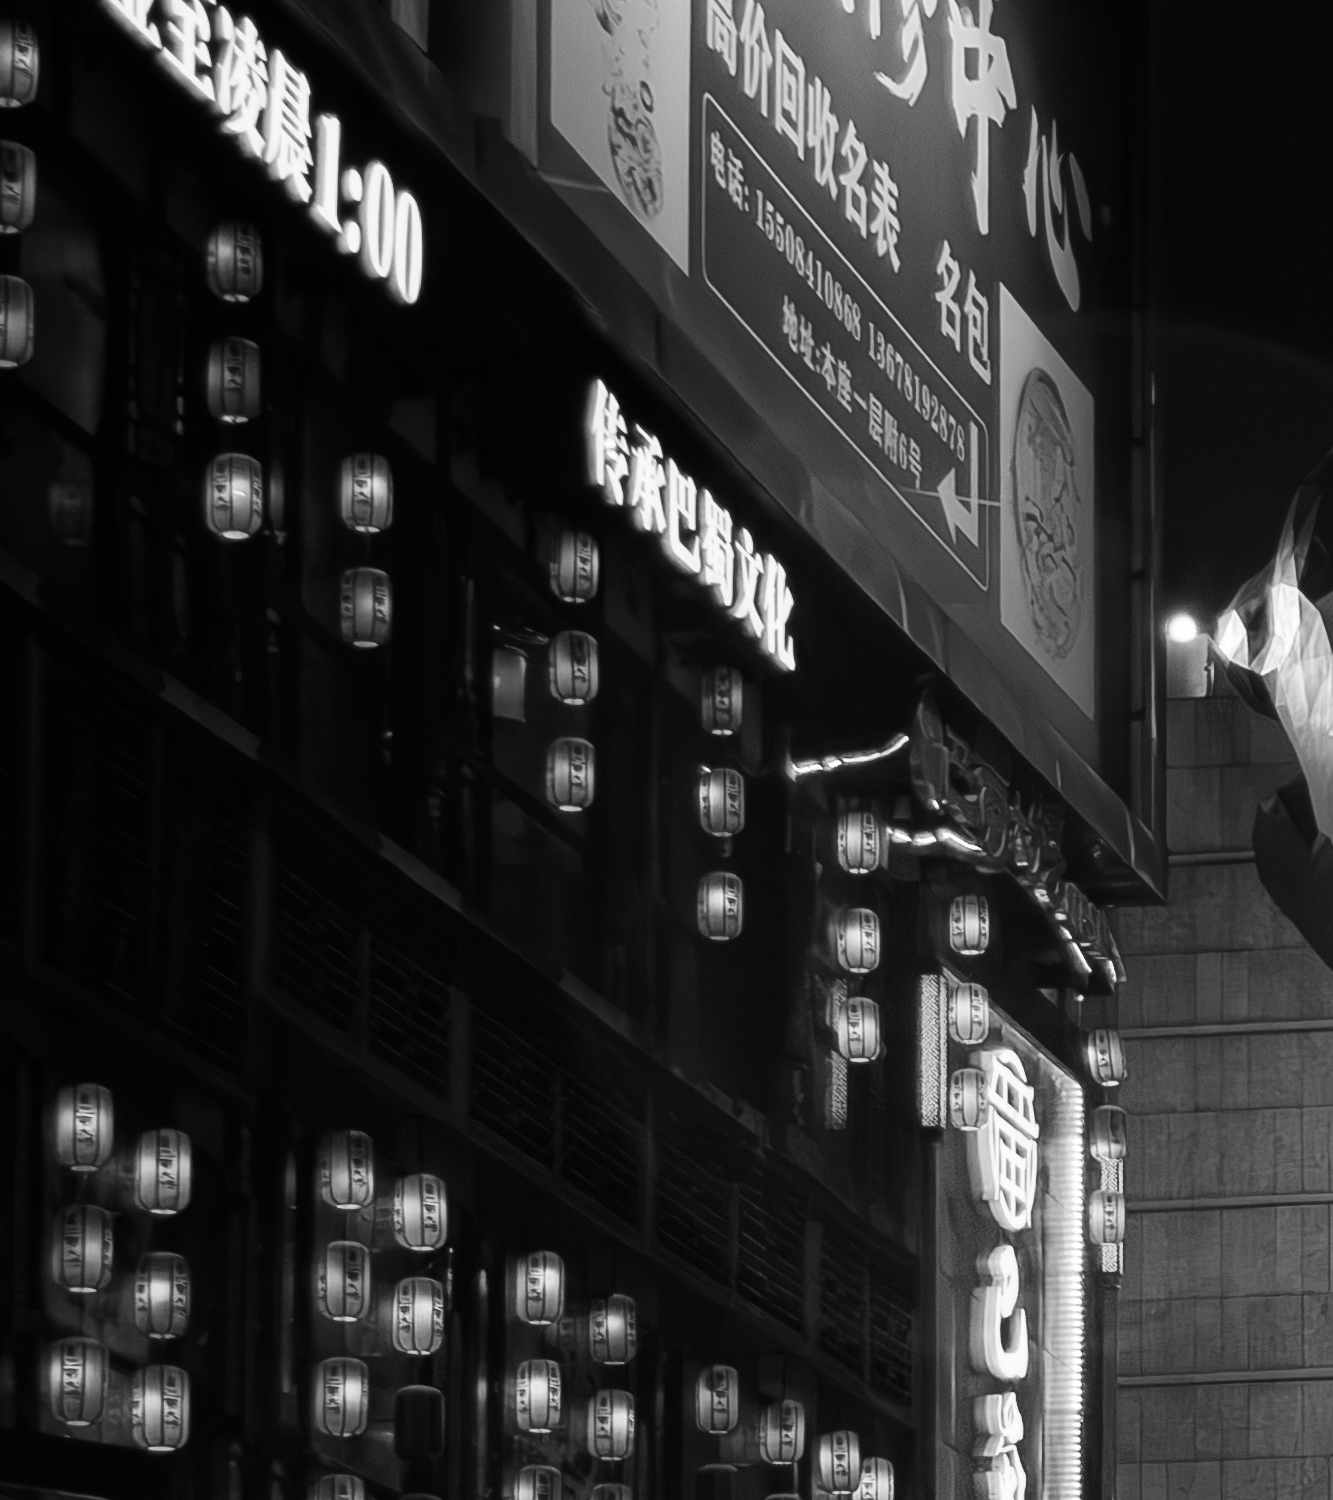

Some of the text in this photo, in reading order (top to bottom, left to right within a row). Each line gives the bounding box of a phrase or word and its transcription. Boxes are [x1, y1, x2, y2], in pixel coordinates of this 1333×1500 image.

[935, 240, 991, 385] 名包
[588, 378, 796, 671] 传承巴蜀文化
